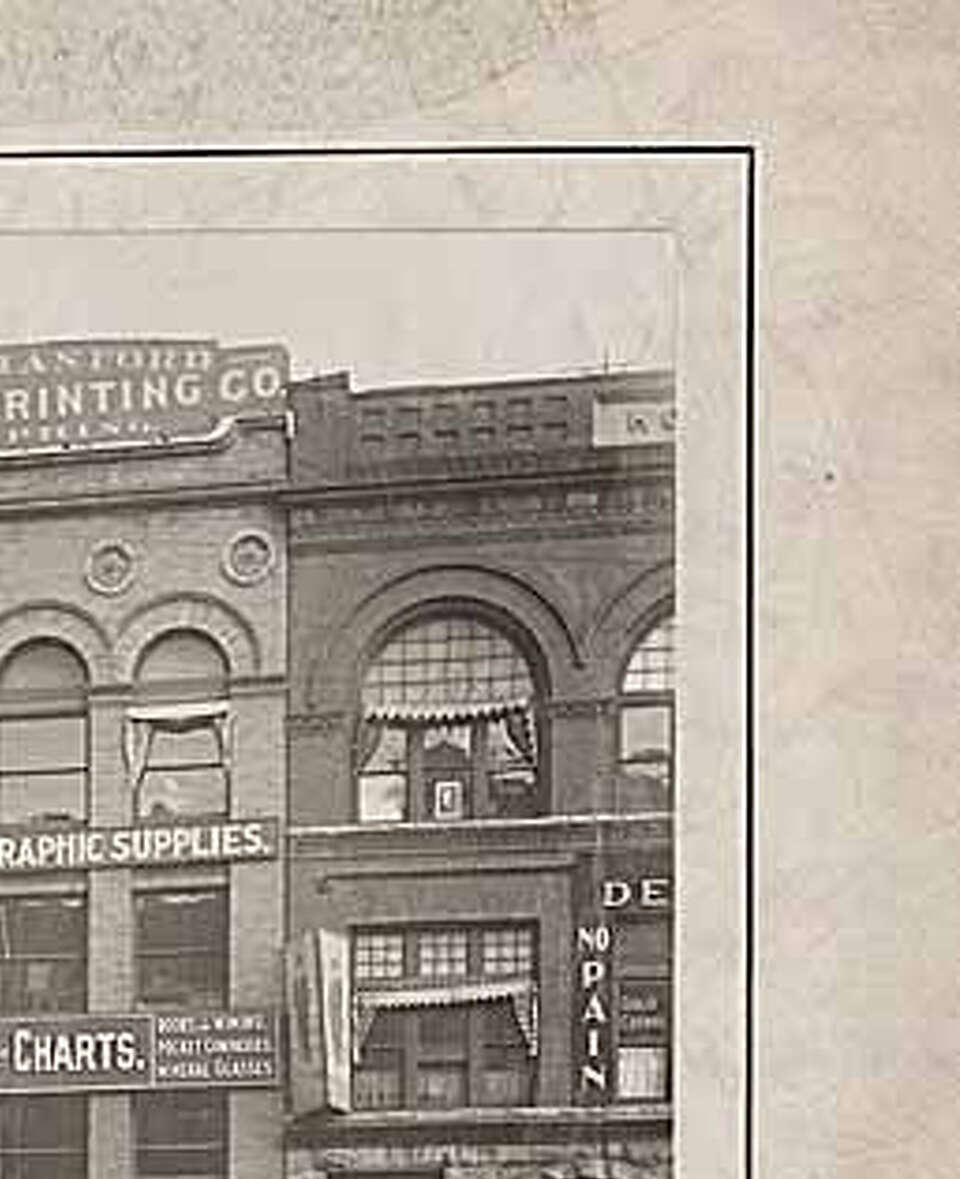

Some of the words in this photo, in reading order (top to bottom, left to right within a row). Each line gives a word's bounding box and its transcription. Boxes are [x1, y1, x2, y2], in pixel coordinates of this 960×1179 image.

[219, 366, 289, 400] CO.
[111, 822, 271, 862] SUPPLIES.
[577, 926, 610, 952] NO
[581, 961, 608, 1090] PAIN
[11, 1028, 146, 1074] CHARTS.
